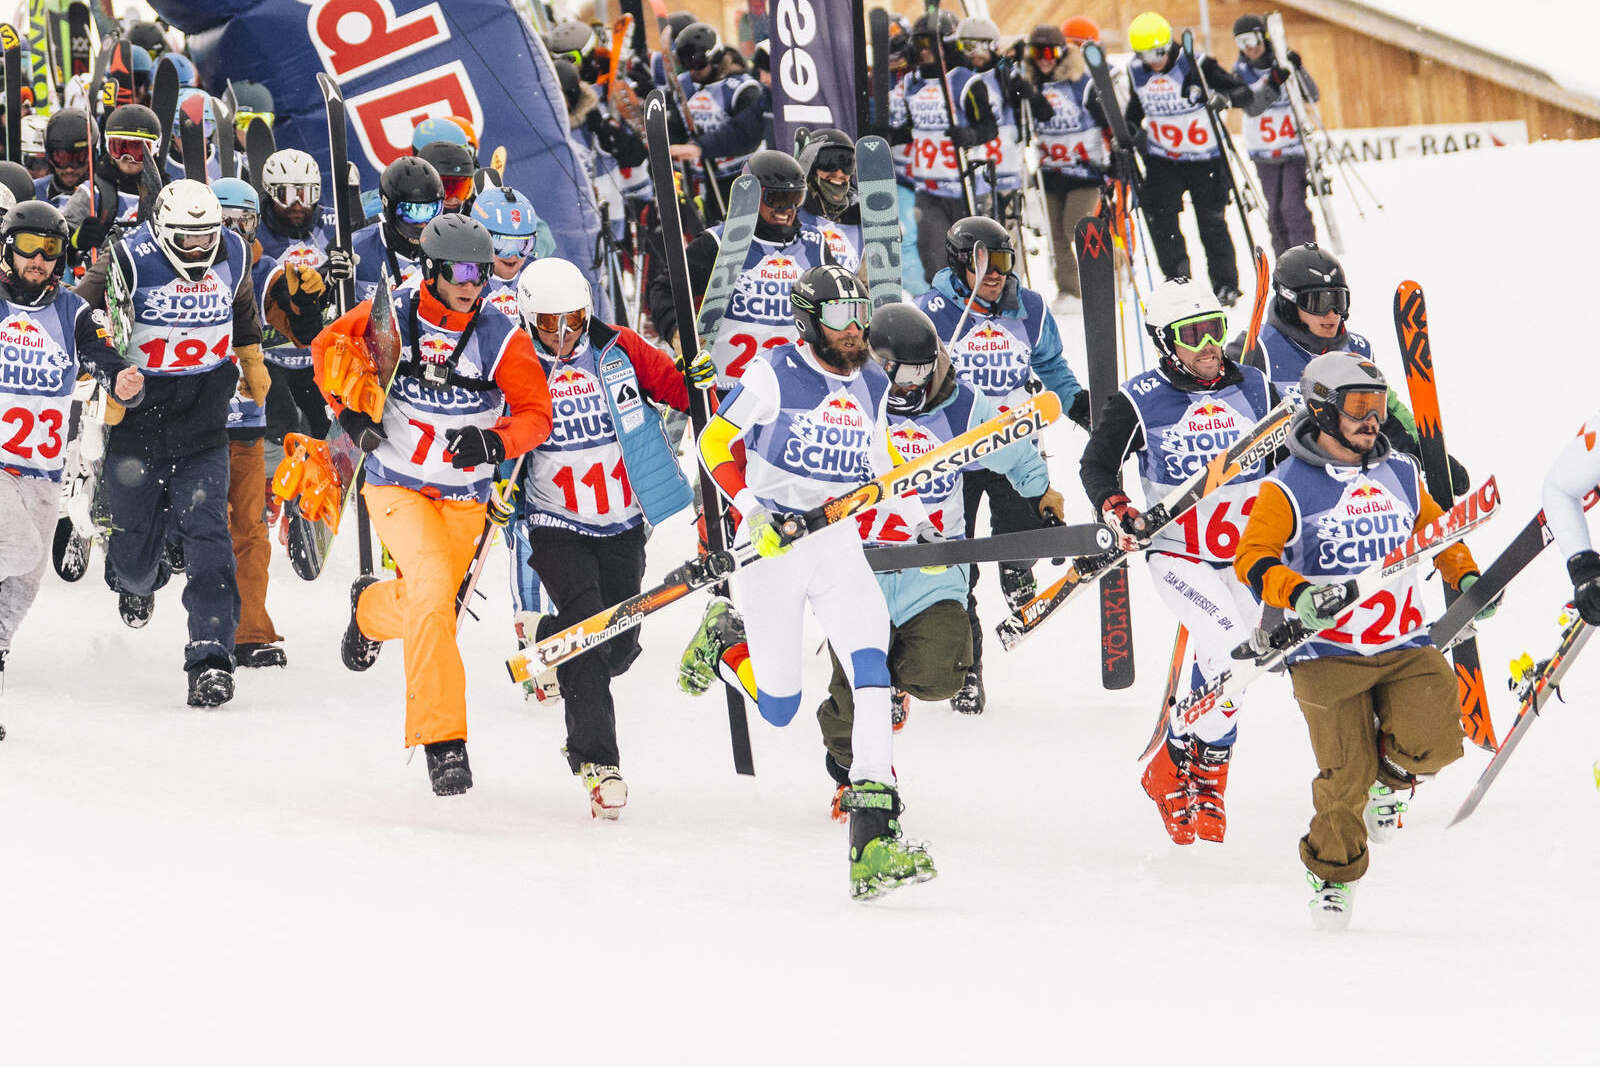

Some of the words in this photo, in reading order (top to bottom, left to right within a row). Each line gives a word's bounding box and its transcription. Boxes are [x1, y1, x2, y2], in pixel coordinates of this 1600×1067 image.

[1150, 119, 1208, 147] 196
[1260, 115, 1296, 142] 54
[801, 230, 821, 244] 231
[135, 242, 157, 257] 181
[303, 257, 319, 266] Bull
[760, 269, 781, 280] Red
[782, 268, 798, 280] Bull
[176, 284, 199, 293] Red
[200, 283, 218, 293] Bull
[754, 281, 793, 296] TOU
[169, 294, 219, 310] TOUT
[928, 296, 945, 312] 60
[0, 332, 21, 345] Red
[22, 335, 44, 348] Bull
[968, 341, 988, 351] Red
[990, 340, 1009, 351] Bull
[961, 352, 1013, 367] TOUT
[957, 369, 1030, 388] CHUSS
[1133, 377, 1161, 396] 162
[551, 386, 573, 399] Red
[575, 383, 595, 395] Bull
[552, 413, 613, 441] CHUS
[823, 412, 843, 425] Red
[844, 415, 863, 427] Bull
[1189, 419, 1213, 432] Red
[1214, 417, 1235, 429] Bull
[815, 424, 865, 448] TOUT
[1183, 429, 1240, 452] TOUT
[893, 412, 1049, 495] ROSSIGNOL
[895, 443, 909, 453] ed
[552, 456, 633, 514] 111
[1346, 503, 1371, 516] Red
[1372, 500, 1394, 513] Bull
[1175, 496, 1258, 559] 16
[1341, 514, 1399, 538] TOUT
[1163, 571, 1179, 588] TEAM
[1184, 584, 1219, 617] UNIVERSITE
[1218, 617, 1234, 631] BPA
